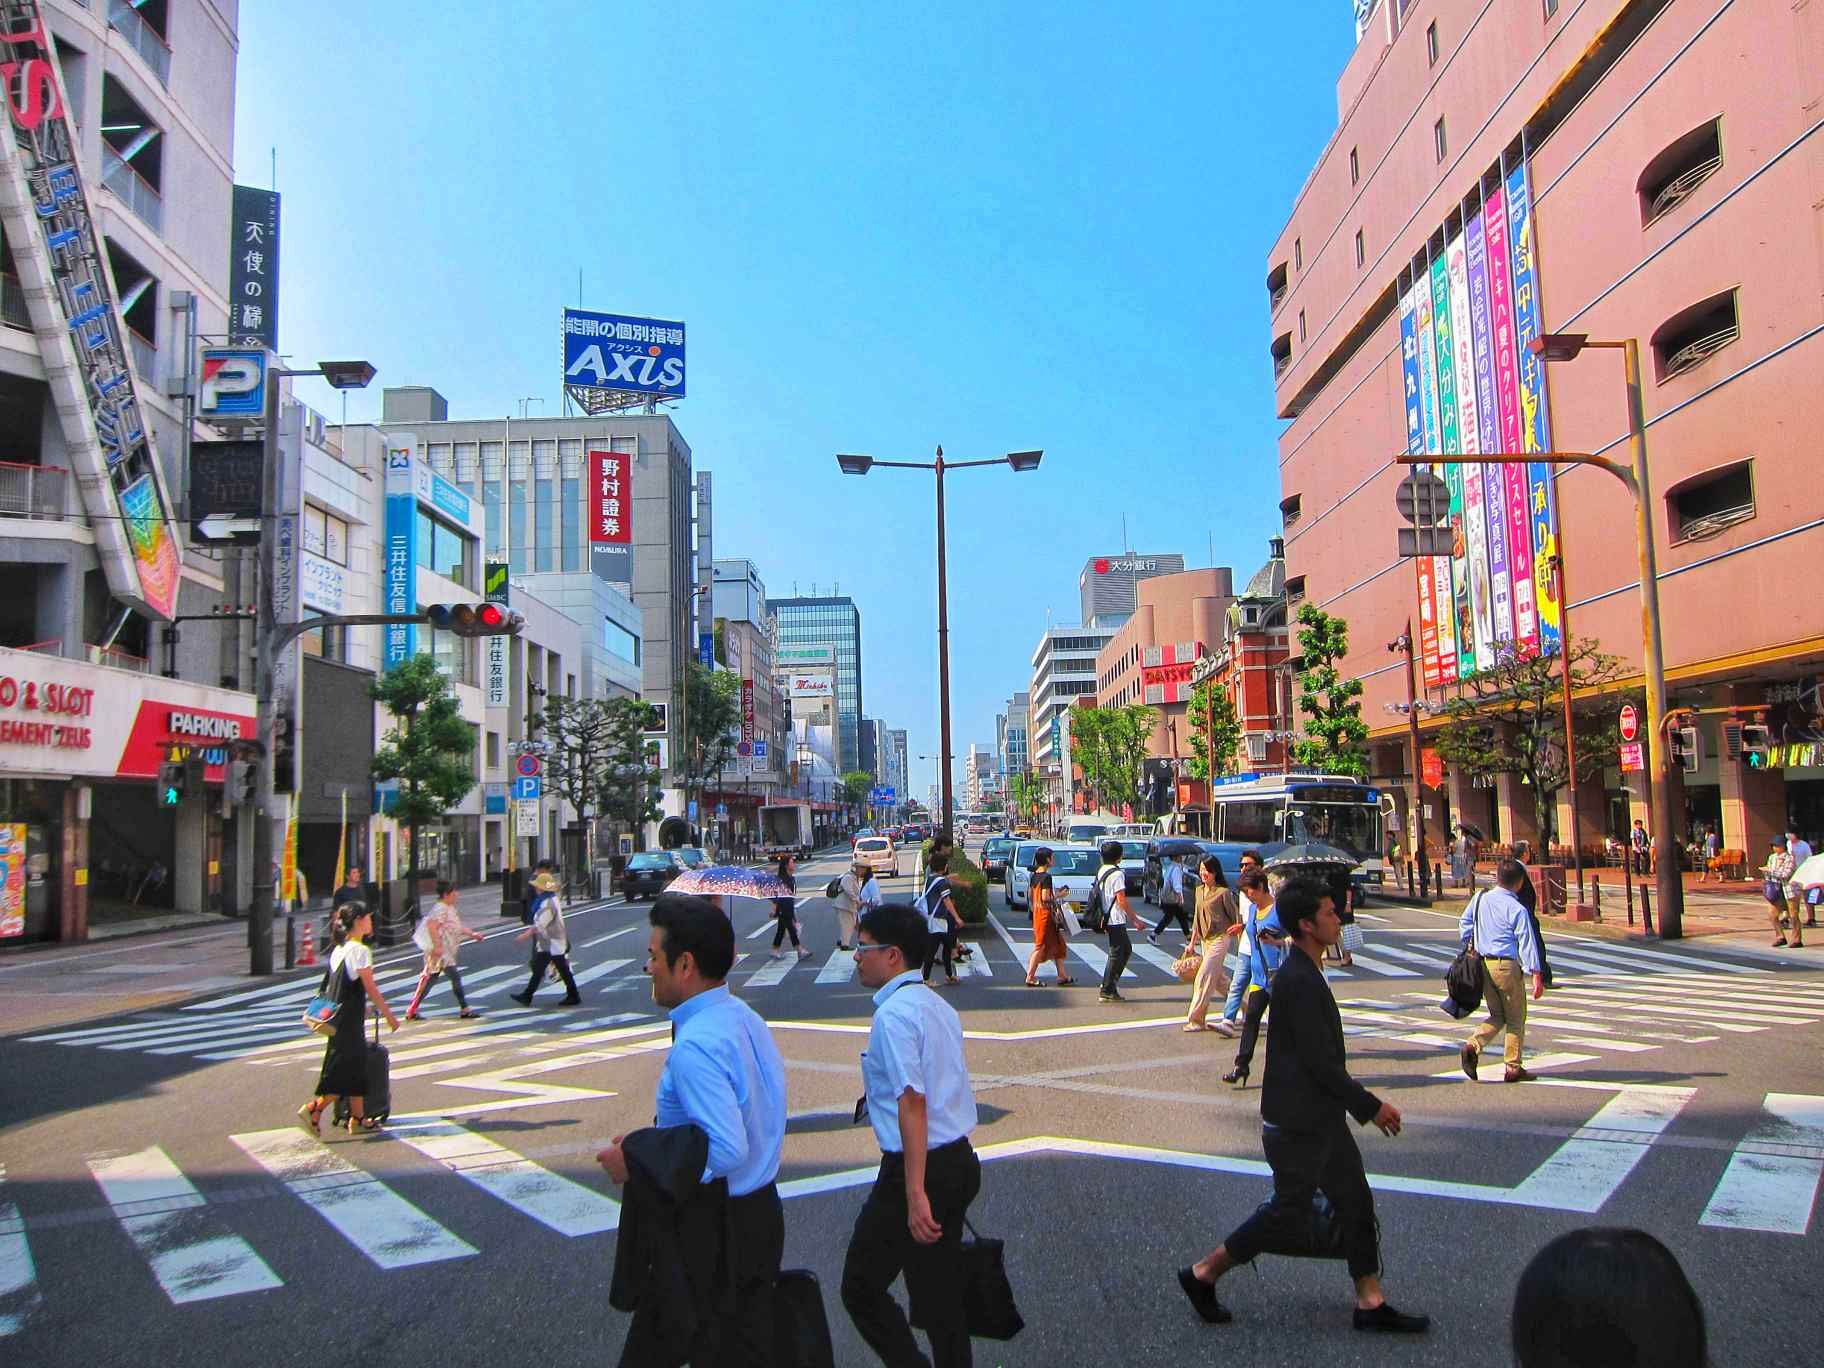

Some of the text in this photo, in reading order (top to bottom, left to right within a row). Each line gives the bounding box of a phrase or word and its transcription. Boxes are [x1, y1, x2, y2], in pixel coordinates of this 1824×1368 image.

[566, 316, 684, 346] 能開の個別指導
[607, 342, 644, 354] アクシス
[202, 359, 261, 409] P
[601, 458, 621, 536] 野村證券
[594, 546, 628, 554] NOMURA
[1111, 560, 1157, 572] 大分銀行
[46, 682, 95, 717] SLOT
[57, 725, 92, 749] ZEUS
[170, 711, 241, 740] PARKING
[522, 779, 536, 797] P
